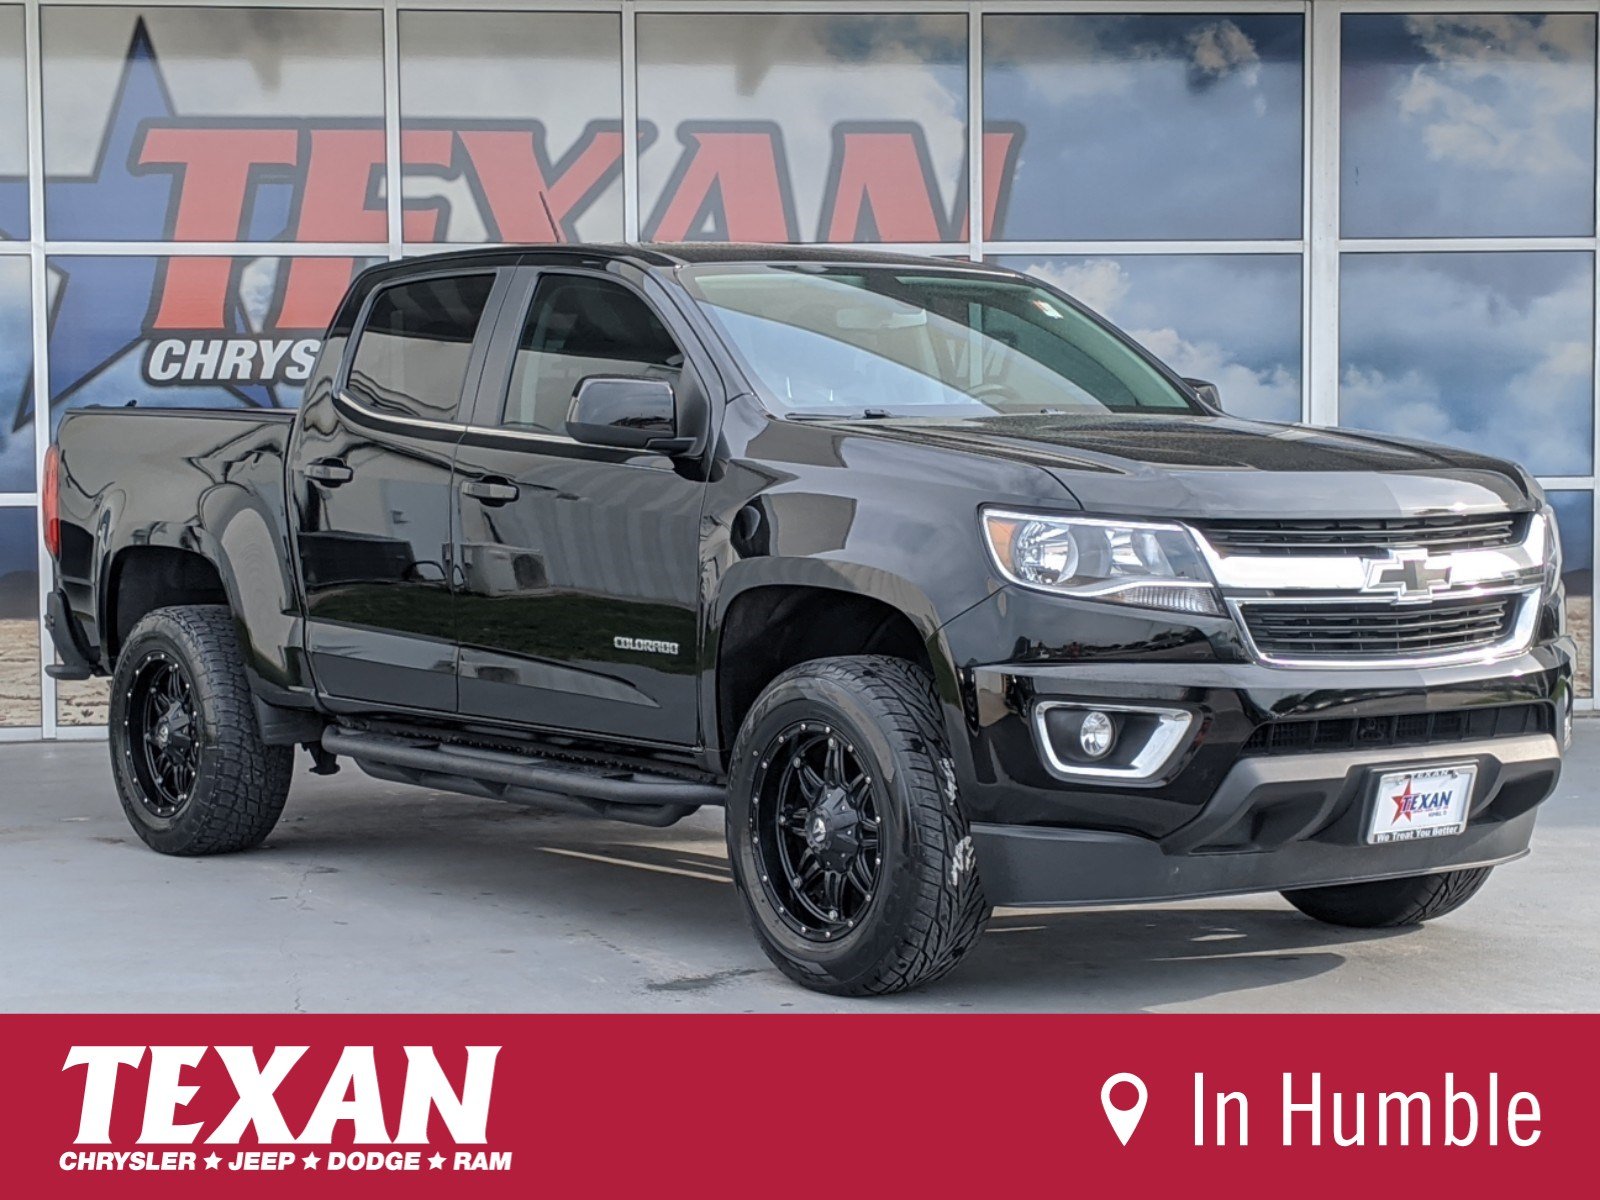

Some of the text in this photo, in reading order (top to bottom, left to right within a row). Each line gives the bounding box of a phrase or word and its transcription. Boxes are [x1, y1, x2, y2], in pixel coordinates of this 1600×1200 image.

[133, 118, 1025, 331] TEXAN
[149, 339, 321, 380] CHRYS
[613, 635, 679, 655] COLORADO
[1402, 790, 1453, 811] TEXAN
[1377, 825, 1458, 843] We Treat You Better
